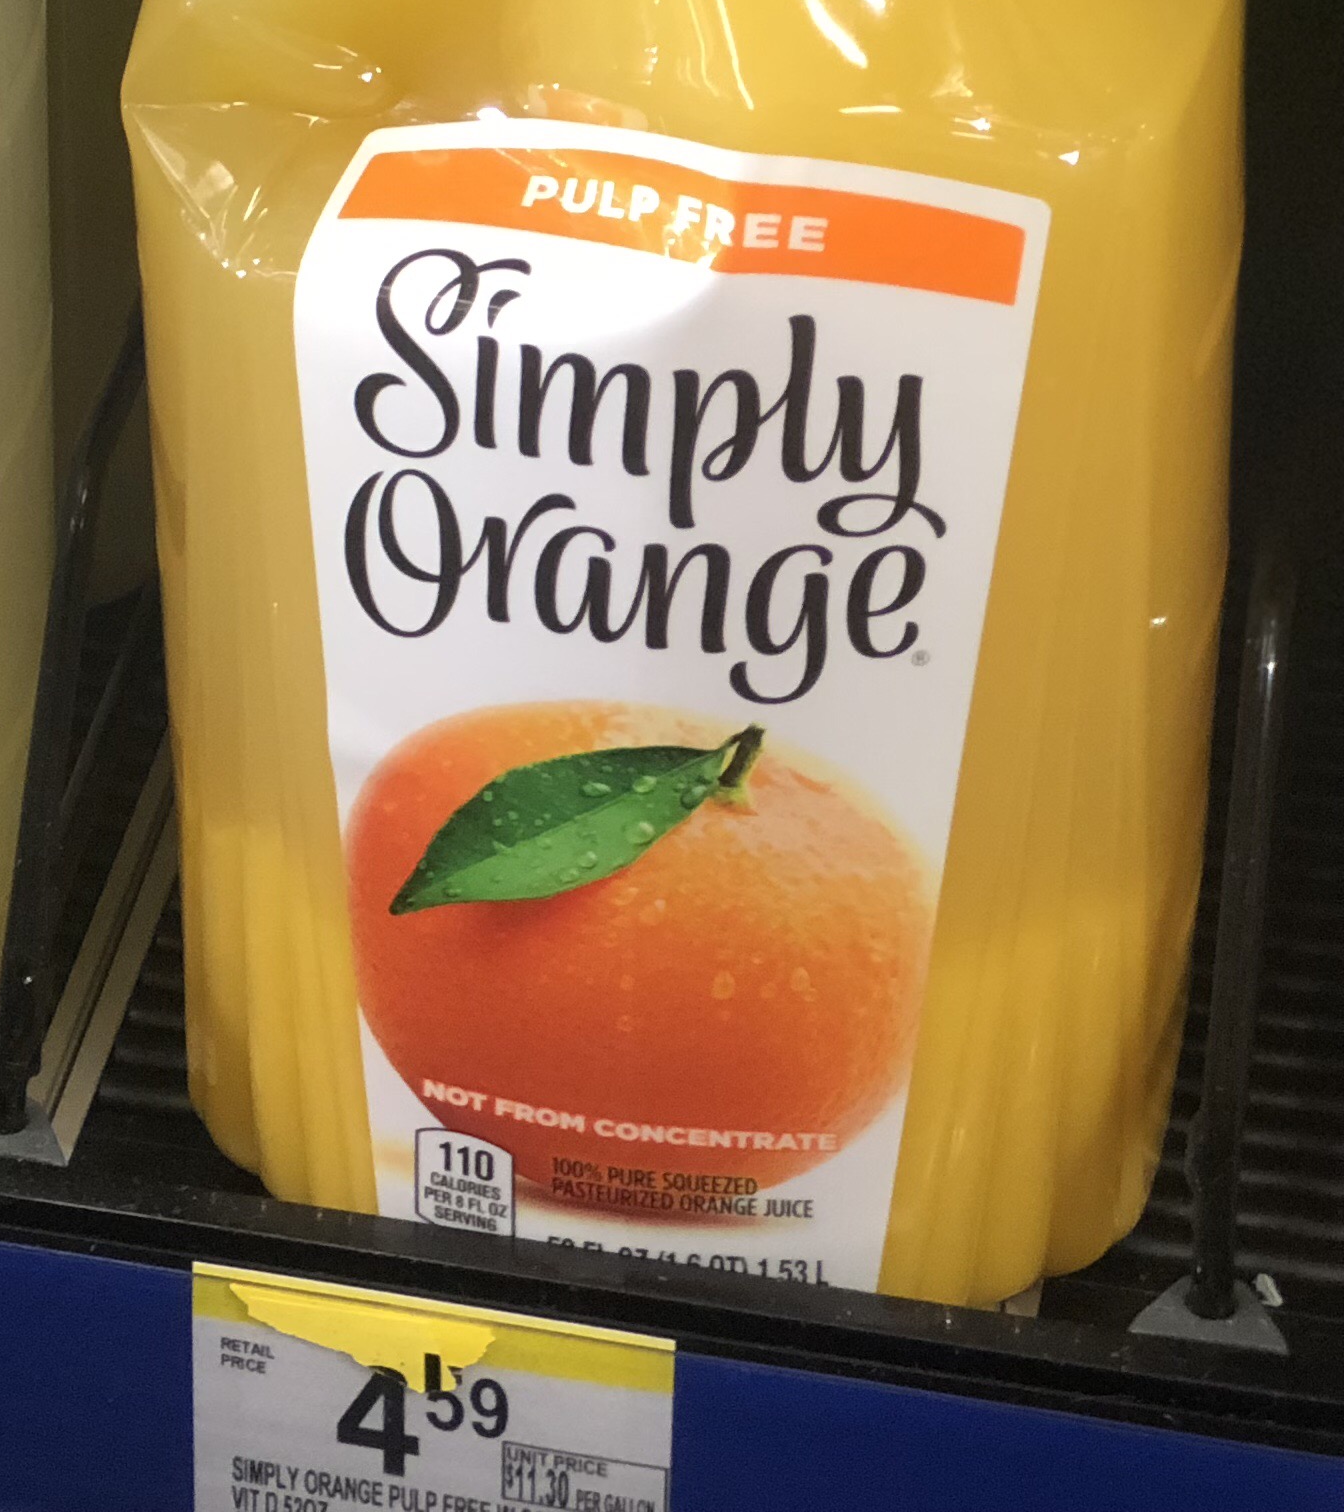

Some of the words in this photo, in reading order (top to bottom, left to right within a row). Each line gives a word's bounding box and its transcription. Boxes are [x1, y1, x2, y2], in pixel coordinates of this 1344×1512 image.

[521, 174, 661, 223] PULP
[674, 196, 830, 254] FREE
[353, 248, 947, 540] Simply
[344, 468, 927, 705] Orange
[422, 1078, 490, 1113] NOT
[494, 1095, 586, 1134] FROM
[593, 1117, 839, 1152] CONCENTRATE
[439, 1141, 495, 1182] 110
[551, 1156, 603, 1183] 100%
[607, 1162, 656, 1189] PURE
[662, 1171, 758, 1197] SQUEEZED
[423, 1185, 452, 1206] PER
[455, 1195, 465, 1208] 8
[467, 1197, 485, 1214] FL
[488, 1203, 510, 1219] OZ
[430, 1171, 501, 1201] CALORIES
[551, 1177, 674, 1212] PASTEURIZED
[679, 1192, 758, 1217] ORANGE
[762, 1197, 814, 1219] JUICE
[433, 1204, 498, 1232] SERVING
[815, 1259, 830, 1287] L
[220, 1336, 275, 1361] RETAIL
[220, 1353, 267, 1375] PRICE
[336, 1368, 420, 1478] 4
[231, 1455, 300, 1491] SIMPLY
[303, 1469, 384, 1508] ORANGE
[388, 1485, 438, 1510] PULP
[506, 1446, 548, 1467] UNIT
[553, 1454, 609, 1478] PRICE
[232, 1486, 261, 1511] VIT
[264, 1491, 278, 1512] D
[503, 1462, 570, 1510] $11.30
[576, 1488, 602, 1512] PER
